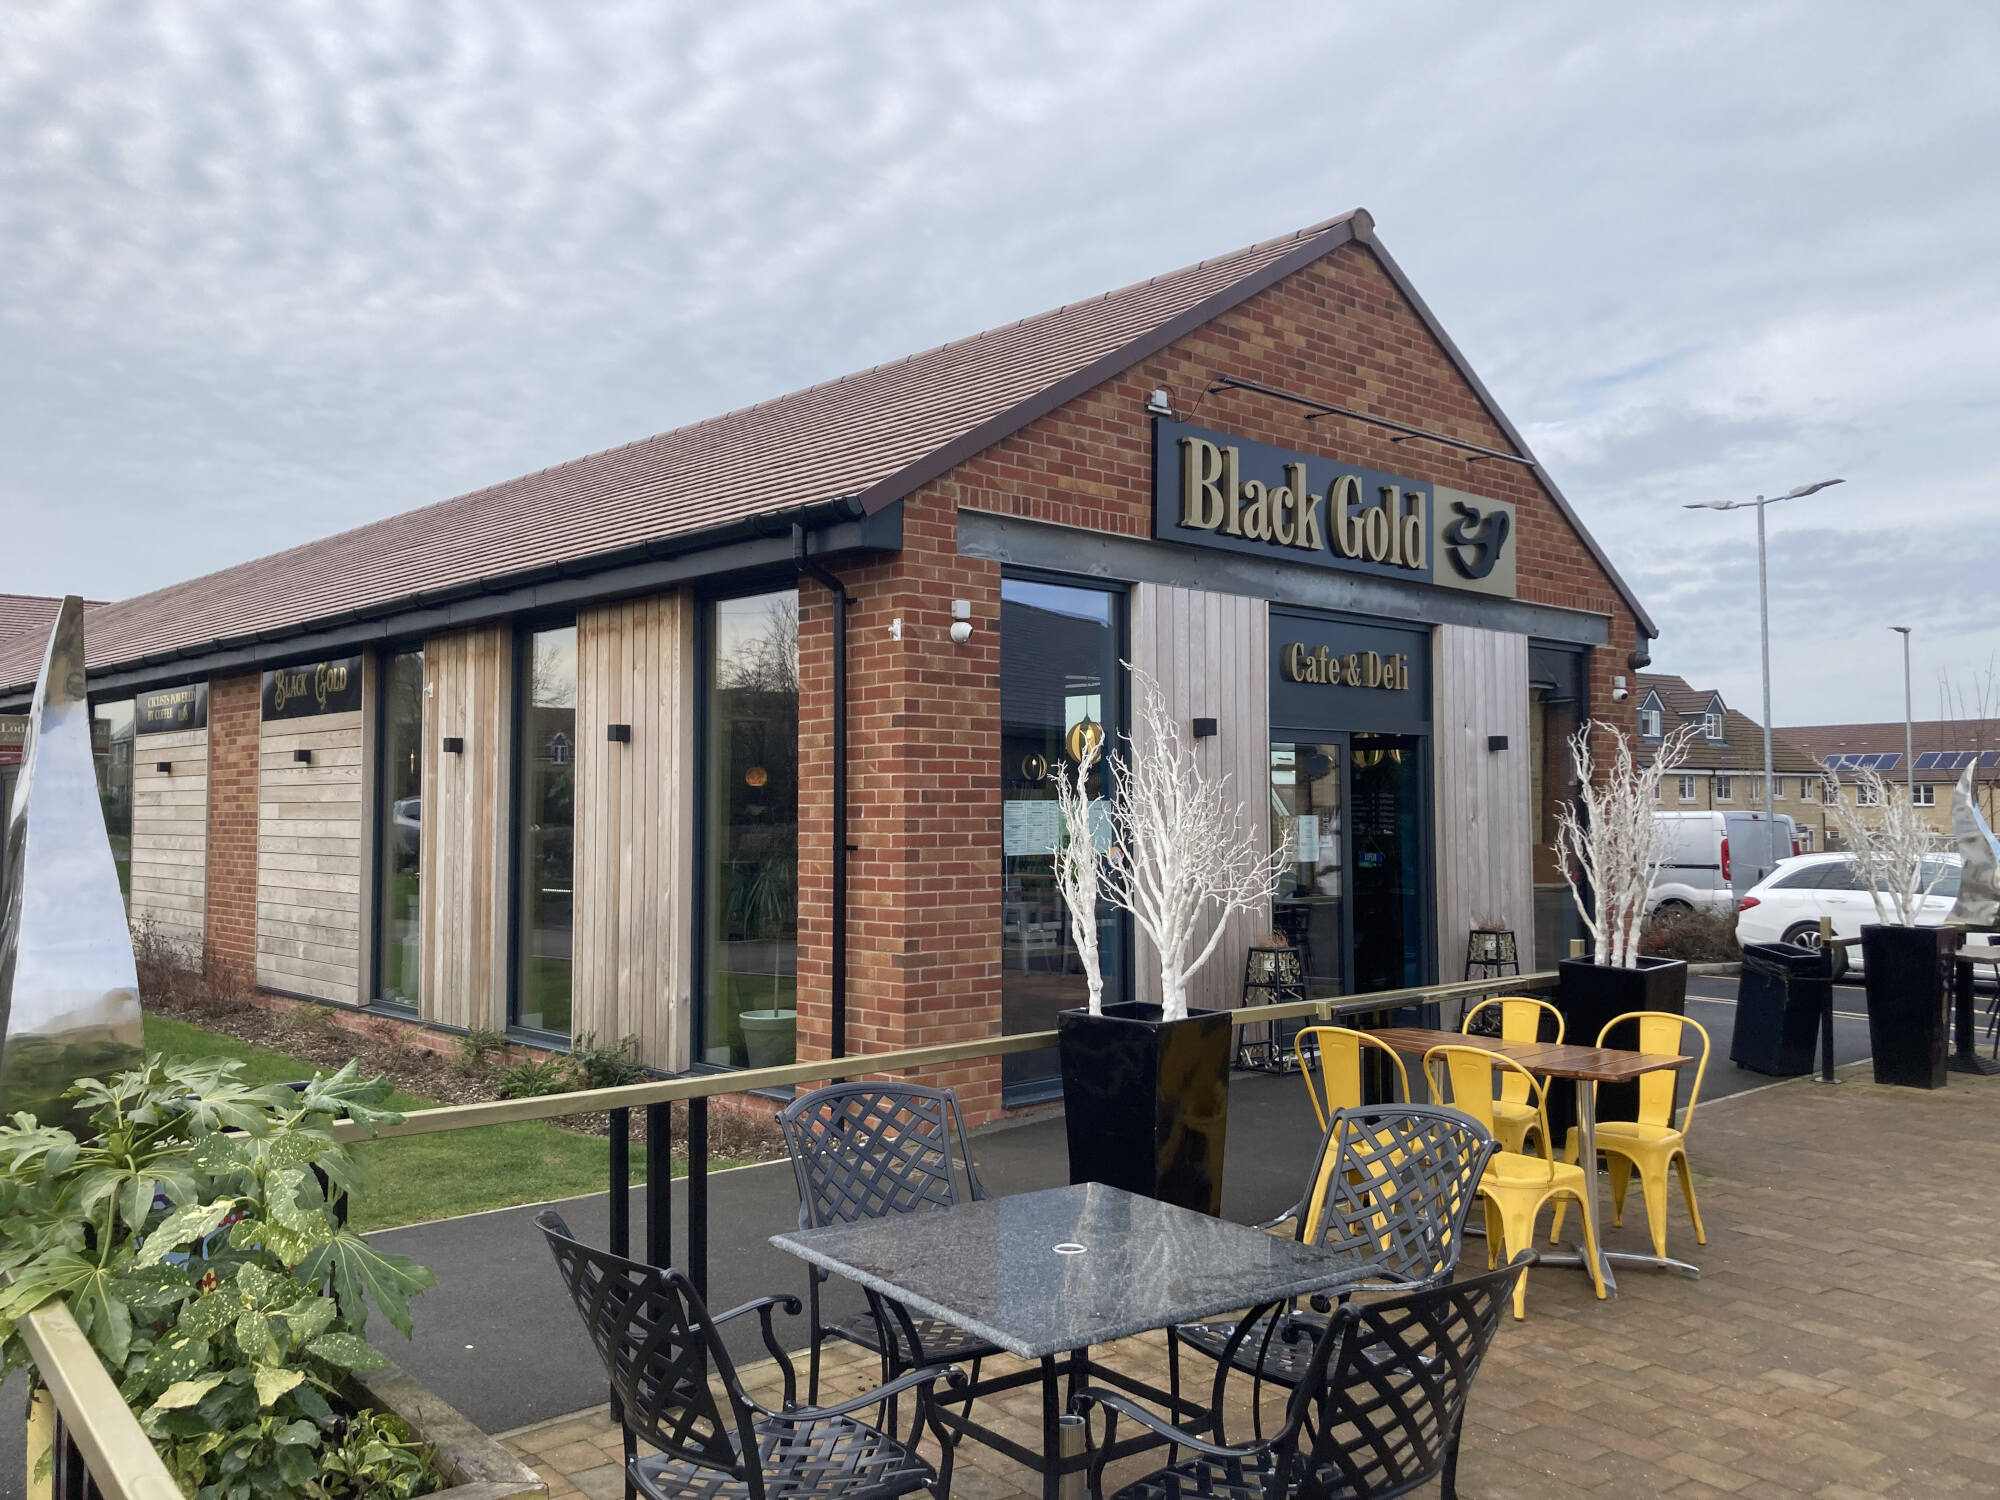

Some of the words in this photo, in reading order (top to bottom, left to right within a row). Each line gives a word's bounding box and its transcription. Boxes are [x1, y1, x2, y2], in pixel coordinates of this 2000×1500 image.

[1180, 436, 1324, 550] Black
[1331, 474, 1428, 570] Gold
[1288, 642, 1340, 685] Cafe
[1344, 653, 1361, 687] &
[1365, 650, 1409, 690] Deli
[1, 723, 26, 733] Lod
